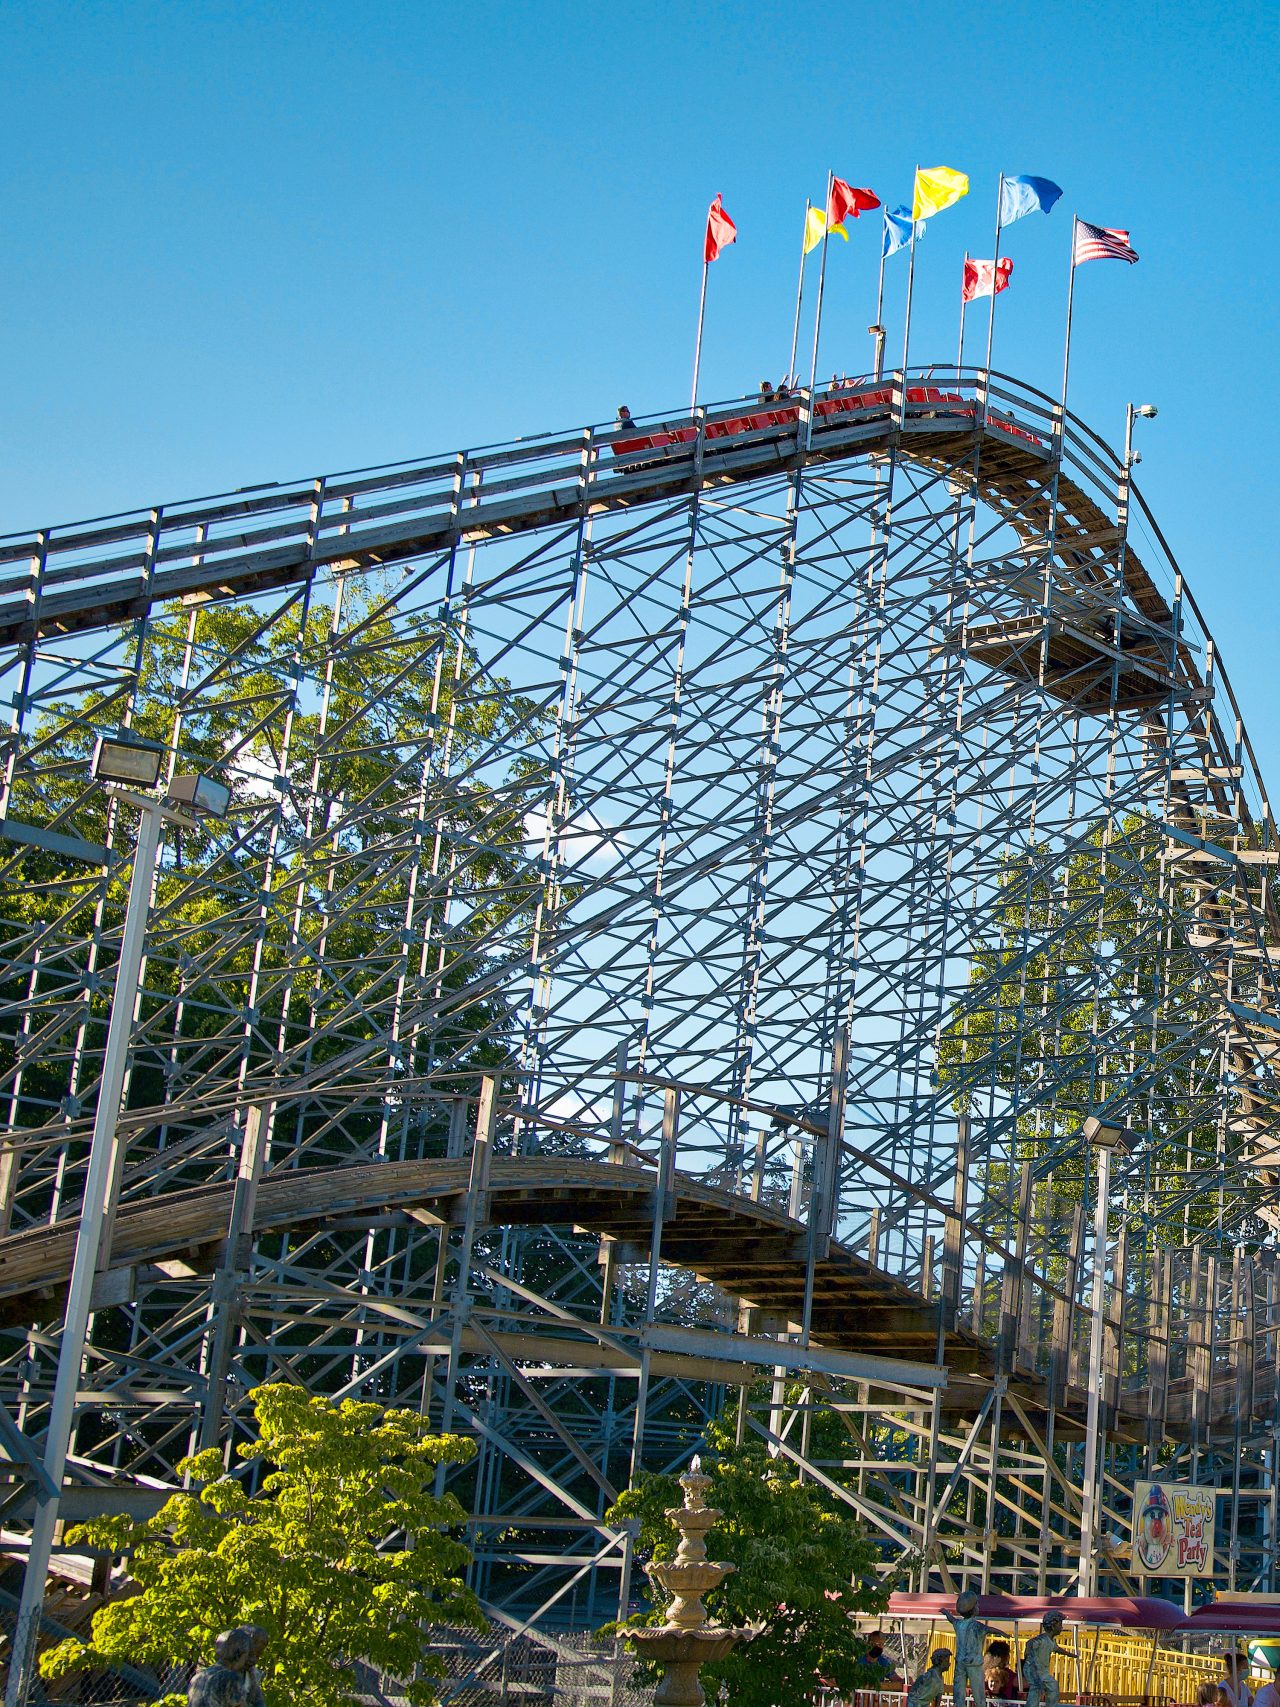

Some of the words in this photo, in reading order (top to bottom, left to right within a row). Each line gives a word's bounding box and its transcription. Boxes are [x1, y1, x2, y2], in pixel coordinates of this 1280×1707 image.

[1173, 1495, 1212, 1519] Wendy's
[1185, 1518, 1202, 1537] Tea
[1179, 1538, 1206, 1568] Party
